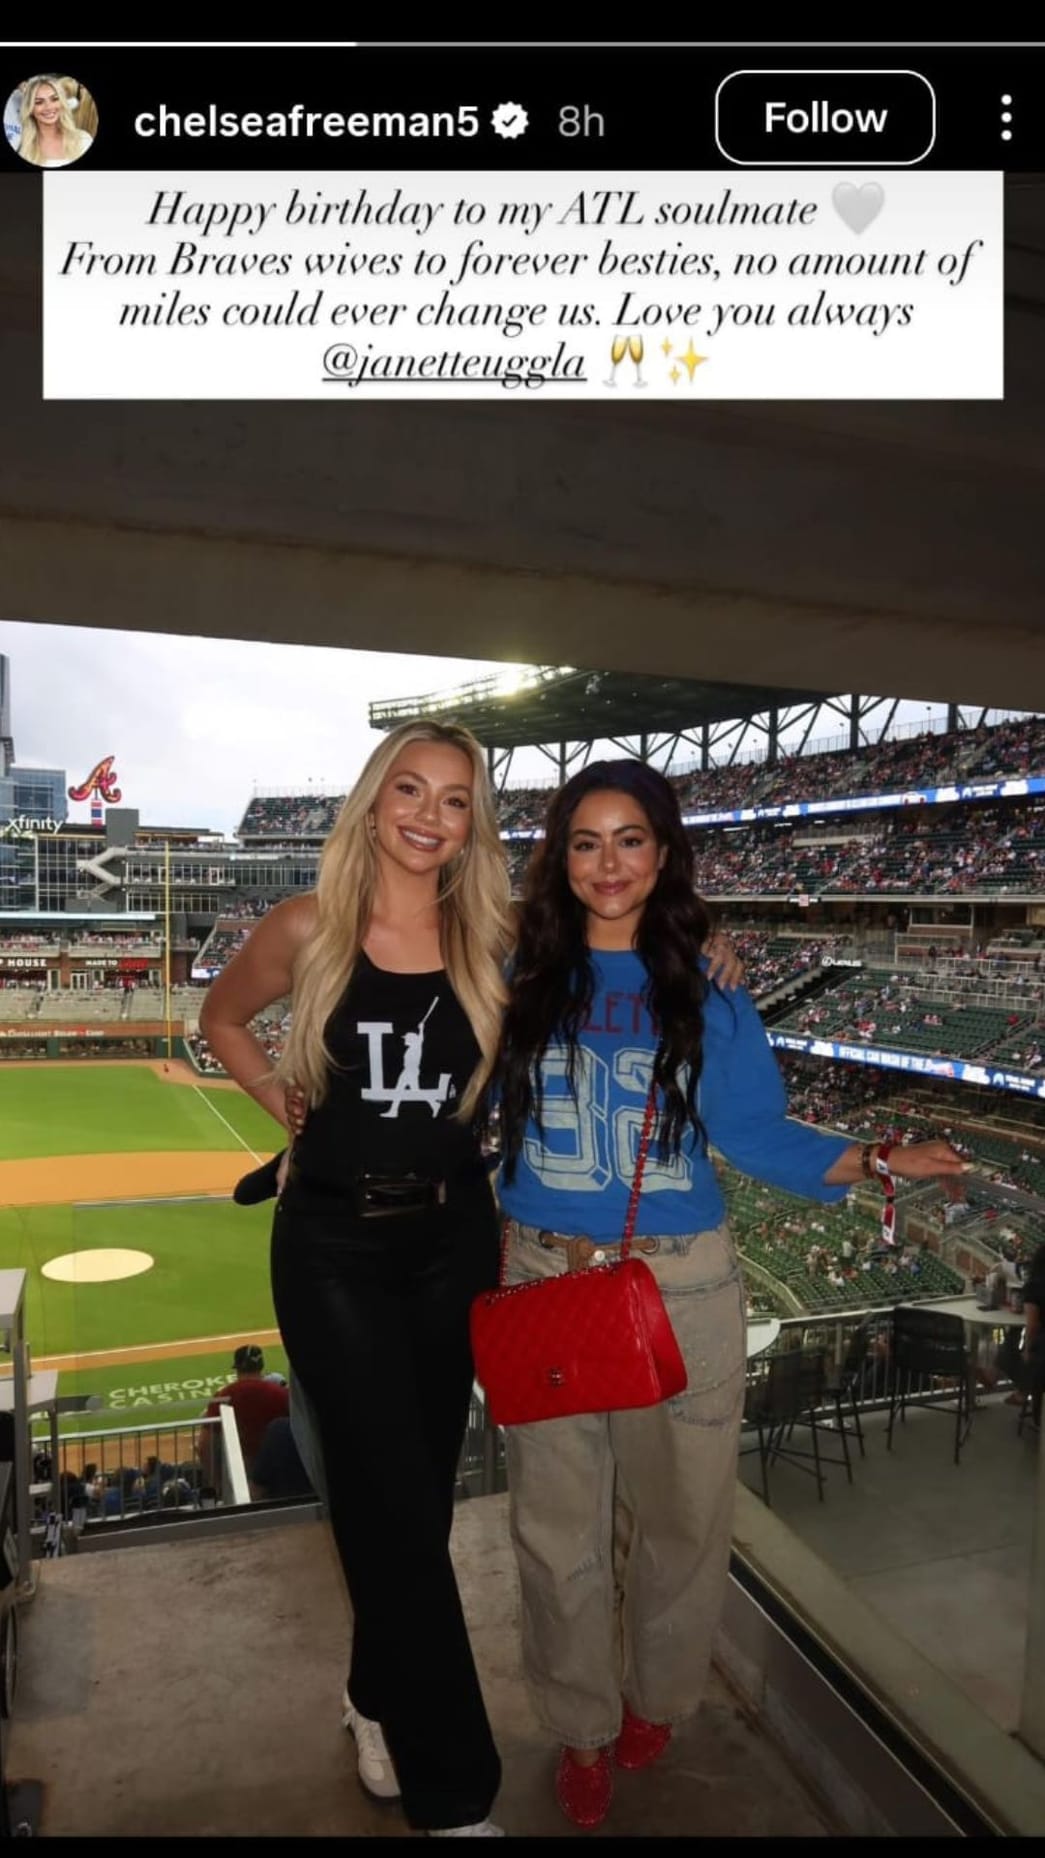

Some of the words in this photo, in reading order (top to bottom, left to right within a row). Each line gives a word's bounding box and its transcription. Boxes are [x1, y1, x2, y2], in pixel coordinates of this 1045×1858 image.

[6, 815, 63, 834] xfinity
[7, 958, 48, 967] HOUSE
[109, 1373, 238, 1399] CHEROKE
[109, 1386, 215, 1409] CASIN
